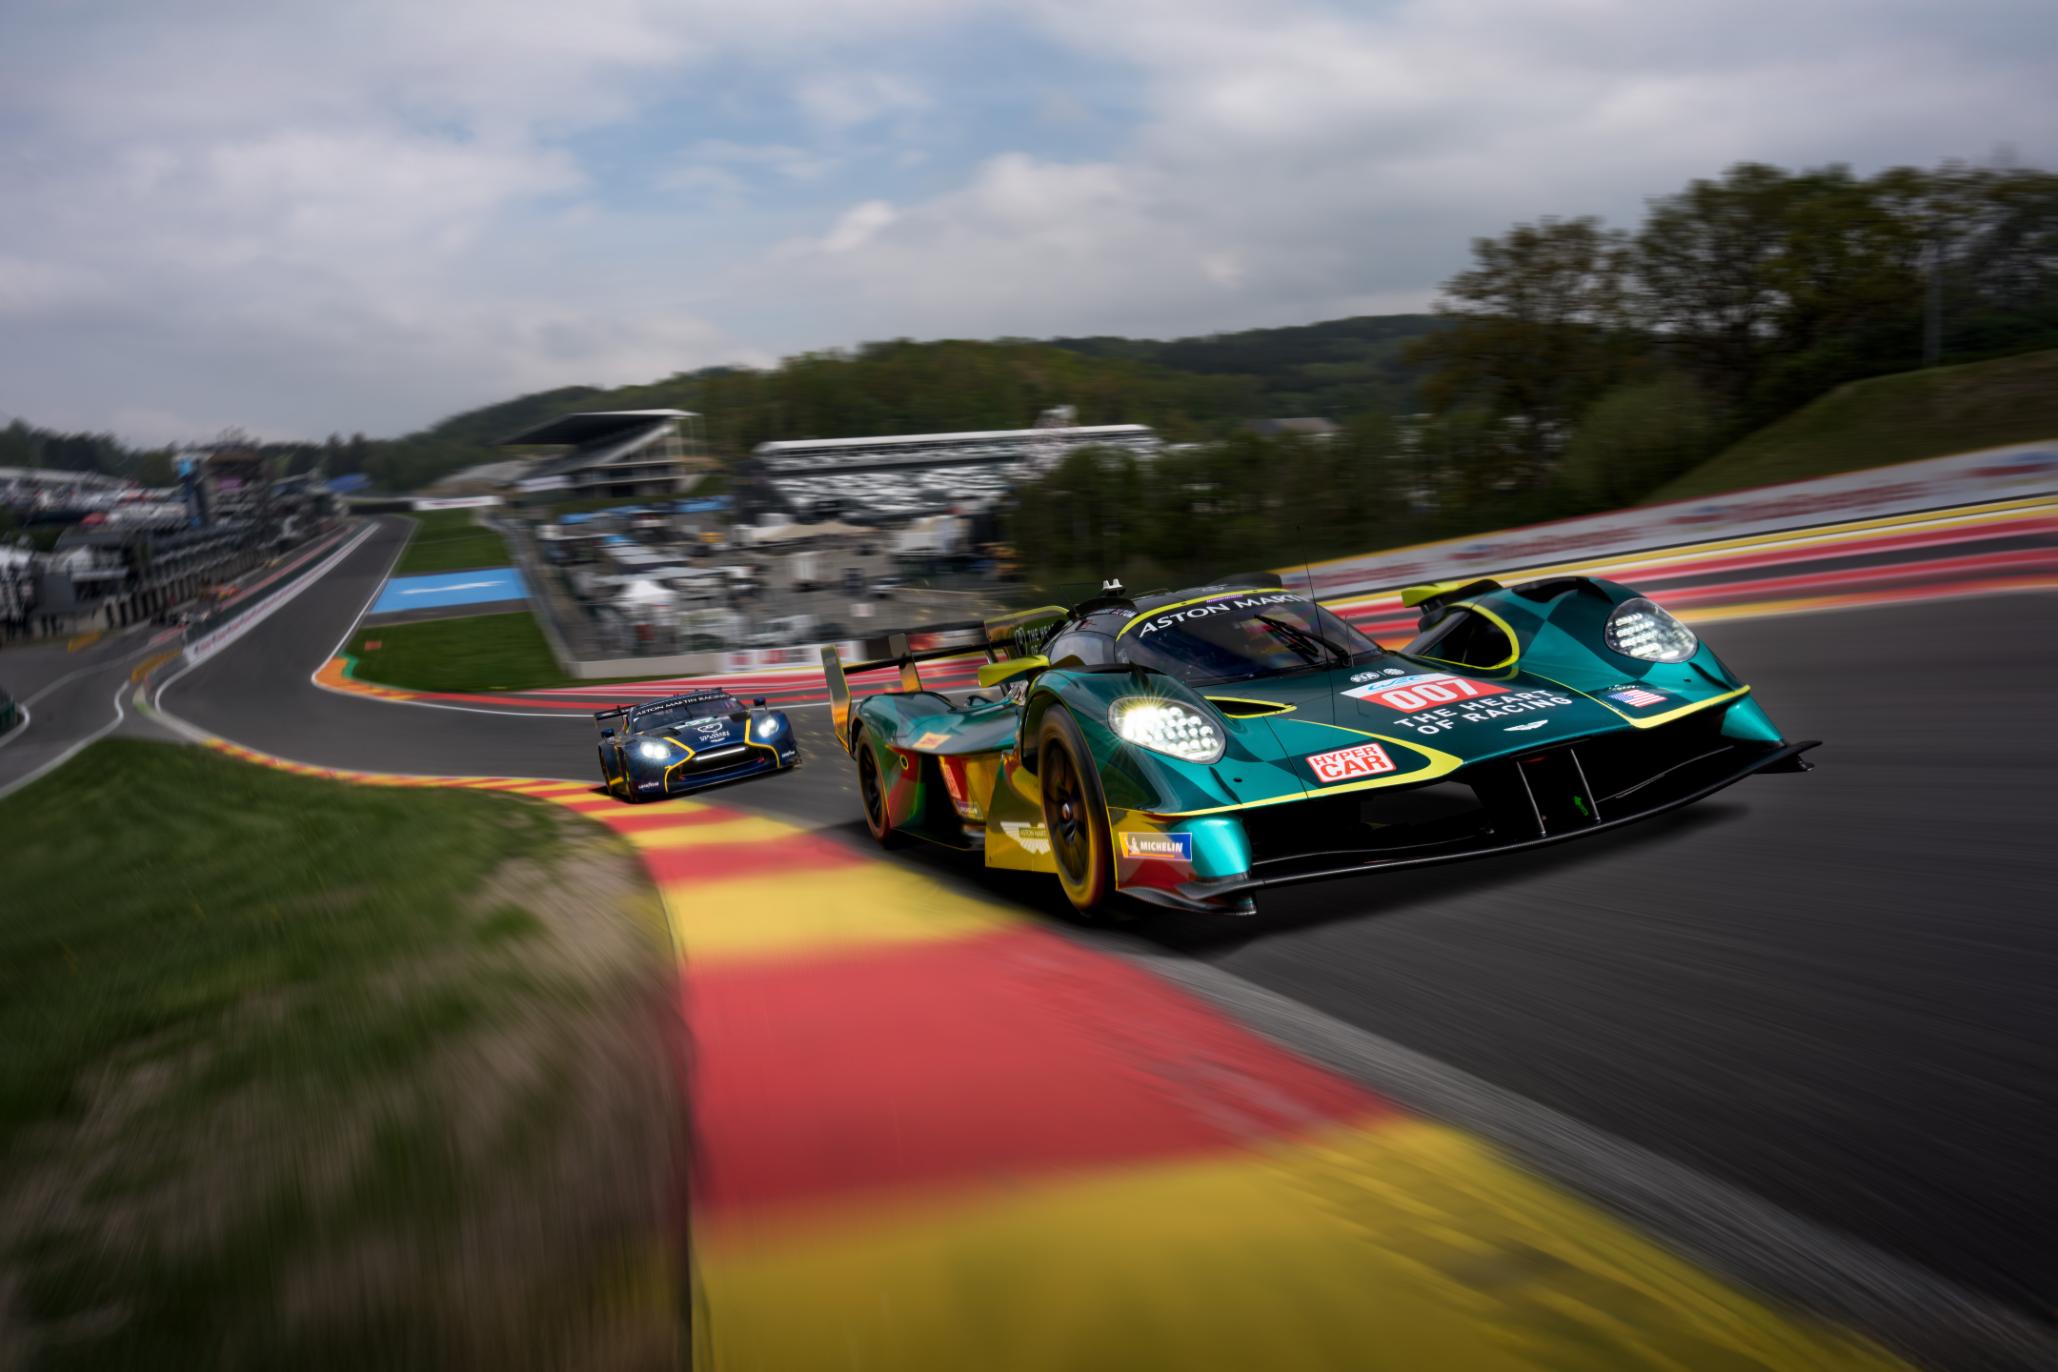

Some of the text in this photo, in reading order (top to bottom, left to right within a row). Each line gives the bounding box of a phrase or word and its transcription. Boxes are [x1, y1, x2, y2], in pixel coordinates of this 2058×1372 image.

[1139, 604, 1230, 638] ASTON
[1381, 678, 1479, 710] 007
[1393, 689, 1553, 728] THE HEART
[1417, 697, 1573, 735] OF RACING
[1313, 746, 1378, 765] HYPER
[1320, 755, 1388, 778] CAR
[1140, 840, 1184, 853] MICHELIN
